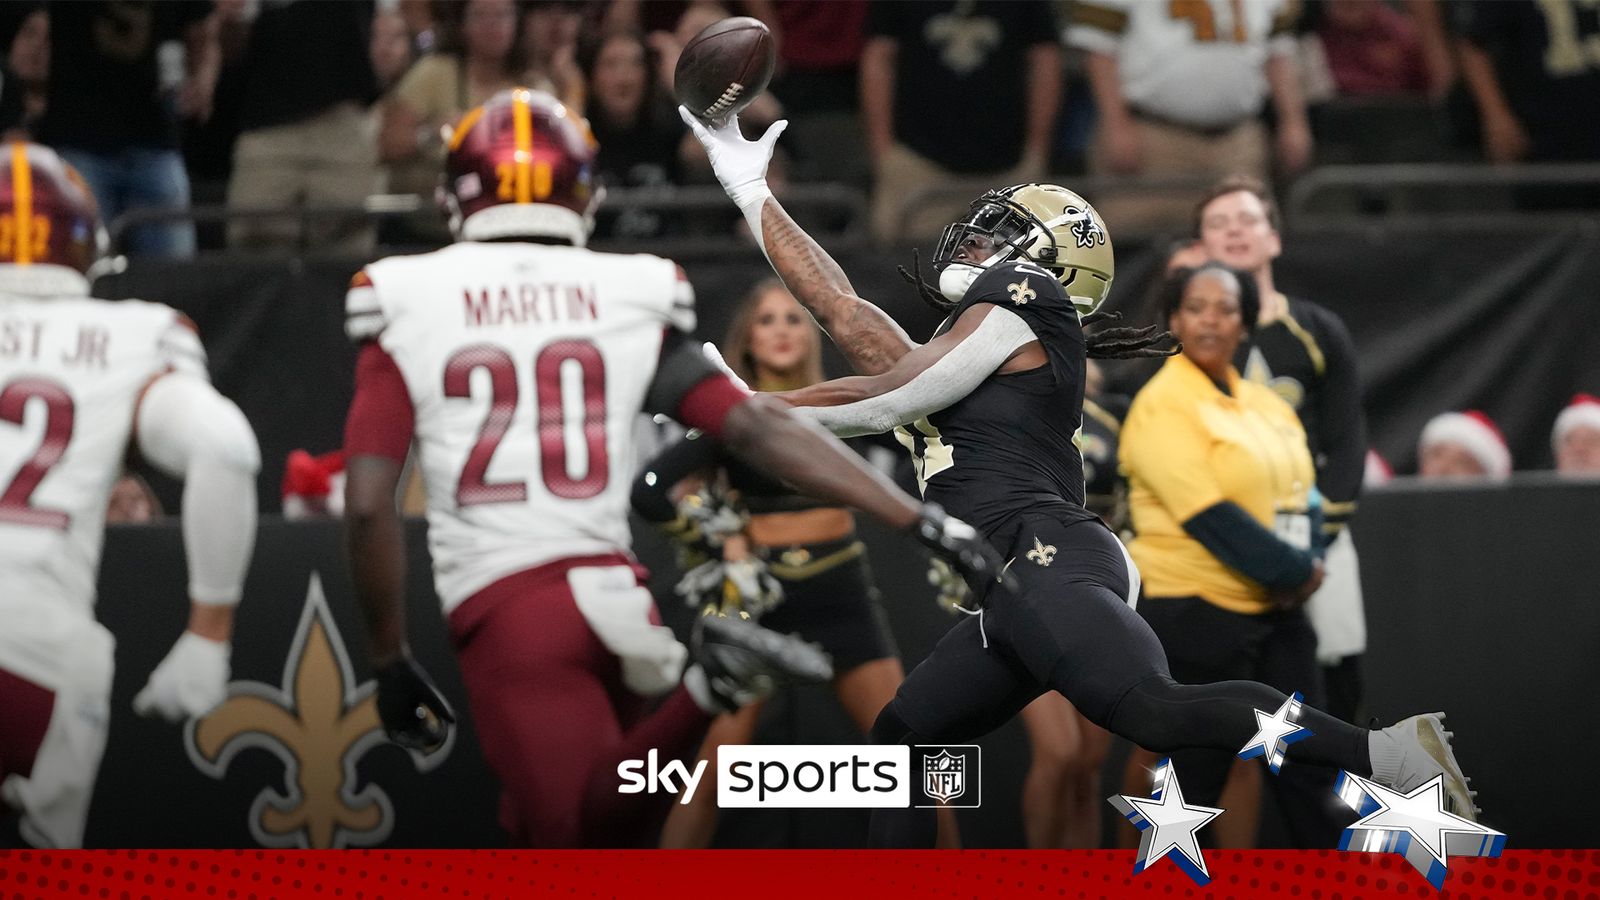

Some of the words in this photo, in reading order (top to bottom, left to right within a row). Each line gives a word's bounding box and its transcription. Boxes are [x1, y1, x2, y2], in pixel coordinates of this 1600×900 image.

[462, 281, 599, 328] MARTIN
[60, 323, 110, 370] JR
[442, 336, 610, 507] 20
